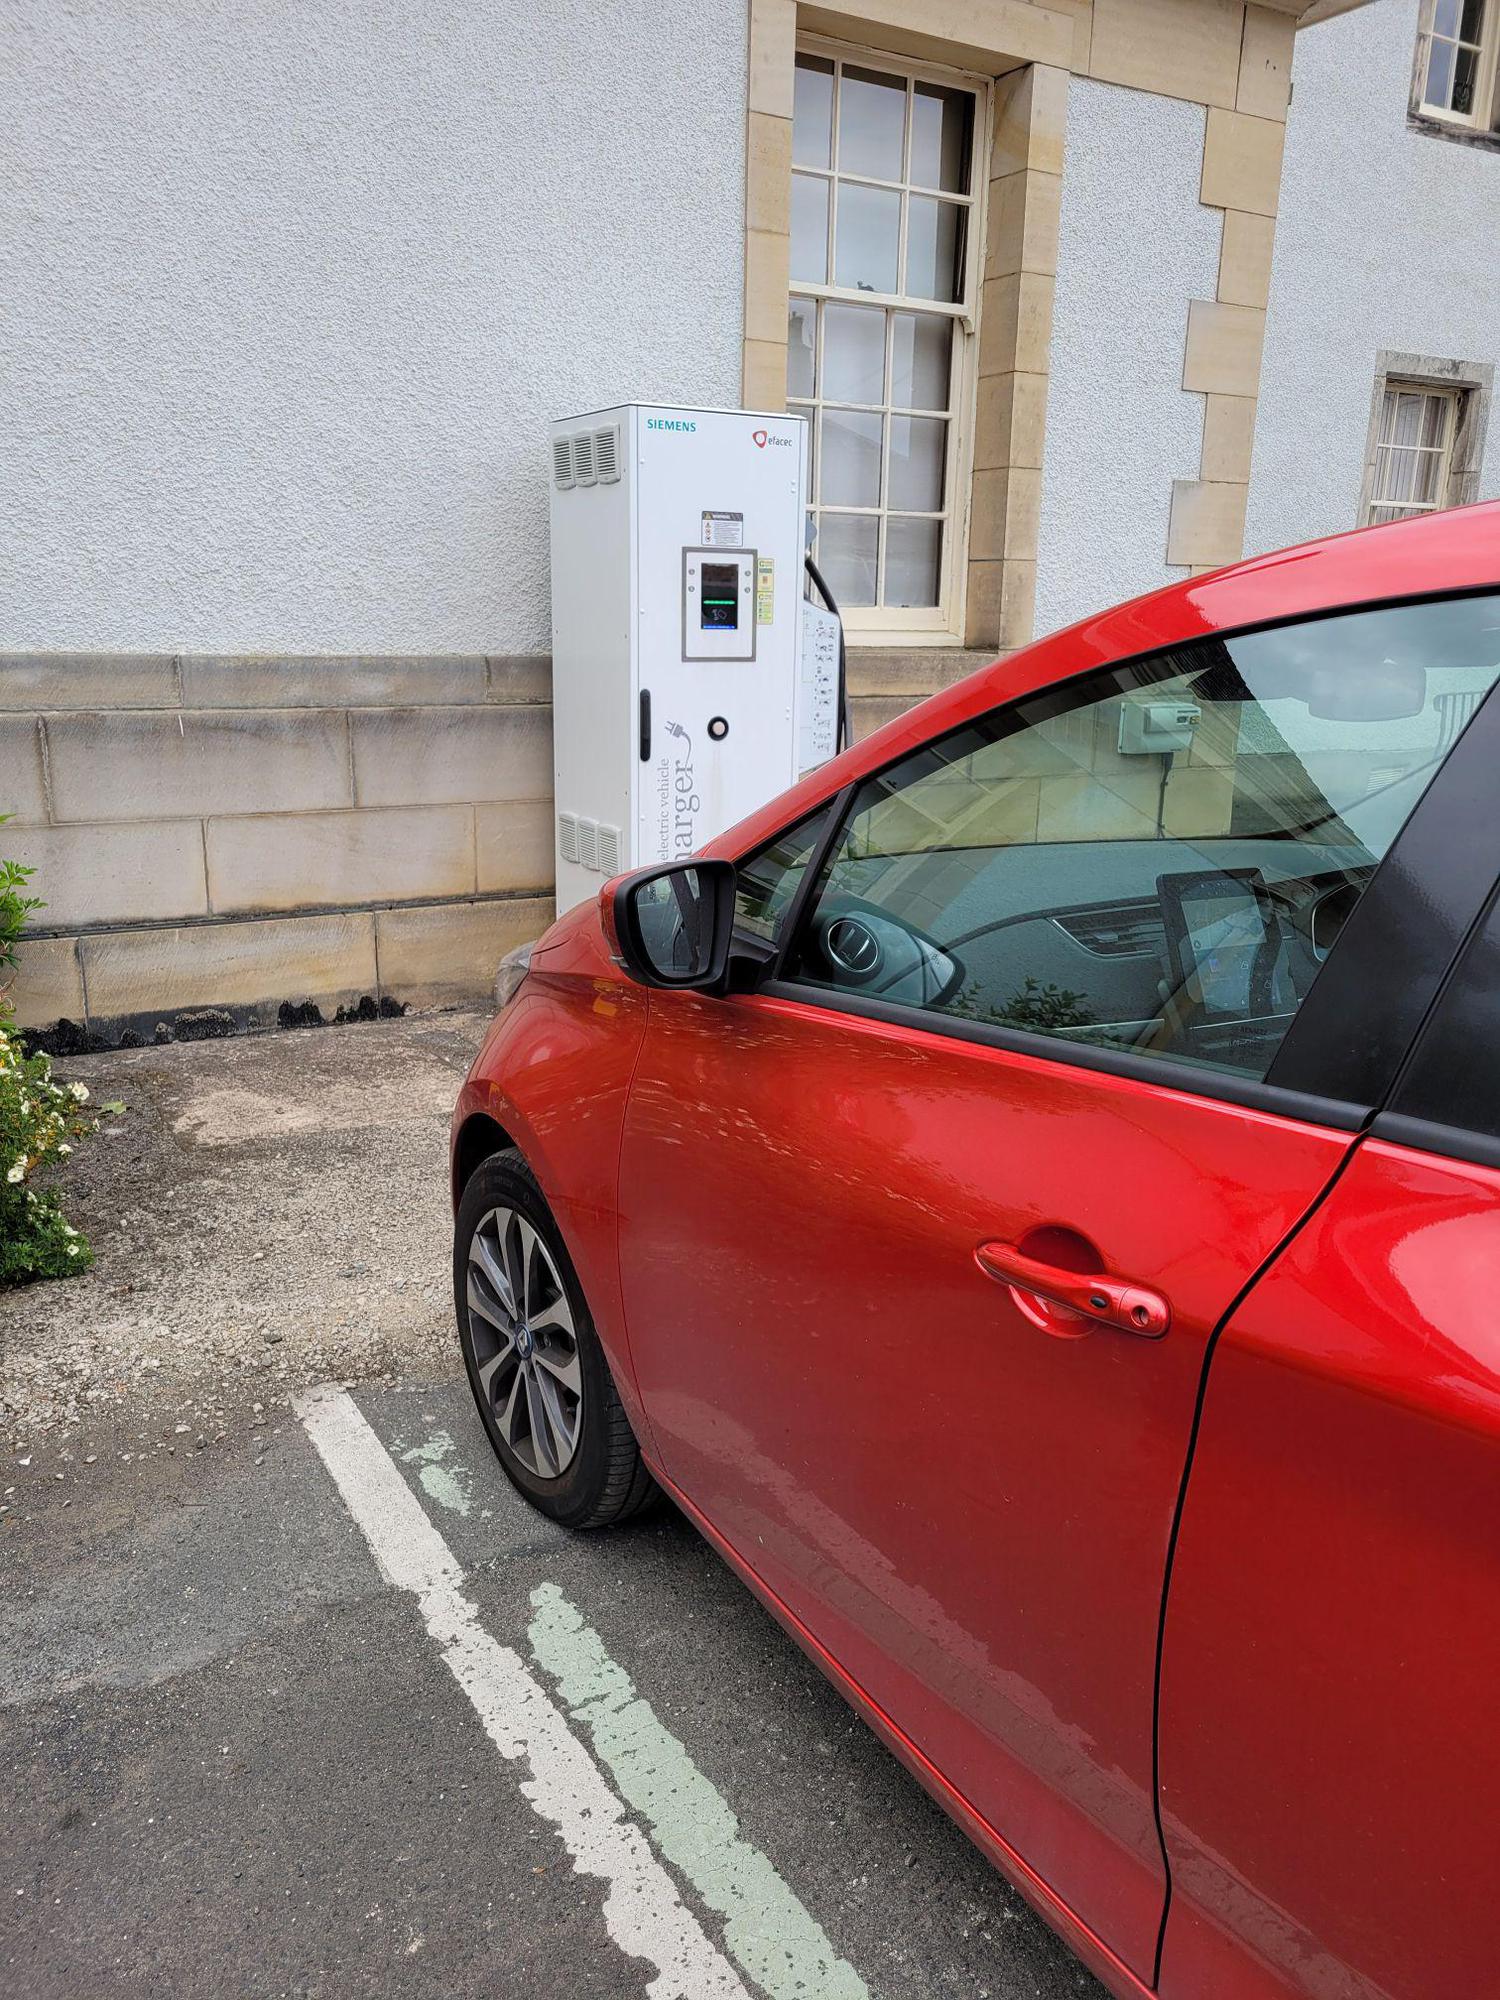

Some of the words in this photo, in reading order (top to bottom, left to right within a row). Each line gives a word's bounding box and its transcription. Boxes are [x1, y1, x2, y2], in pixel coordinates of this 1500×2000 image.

[647, 418, 697, 432] SIEMENS
[767, 435, 793, 447] efacec
[657, 758, 669, 807] vehicle
[657, 810, 669, 861] electric
